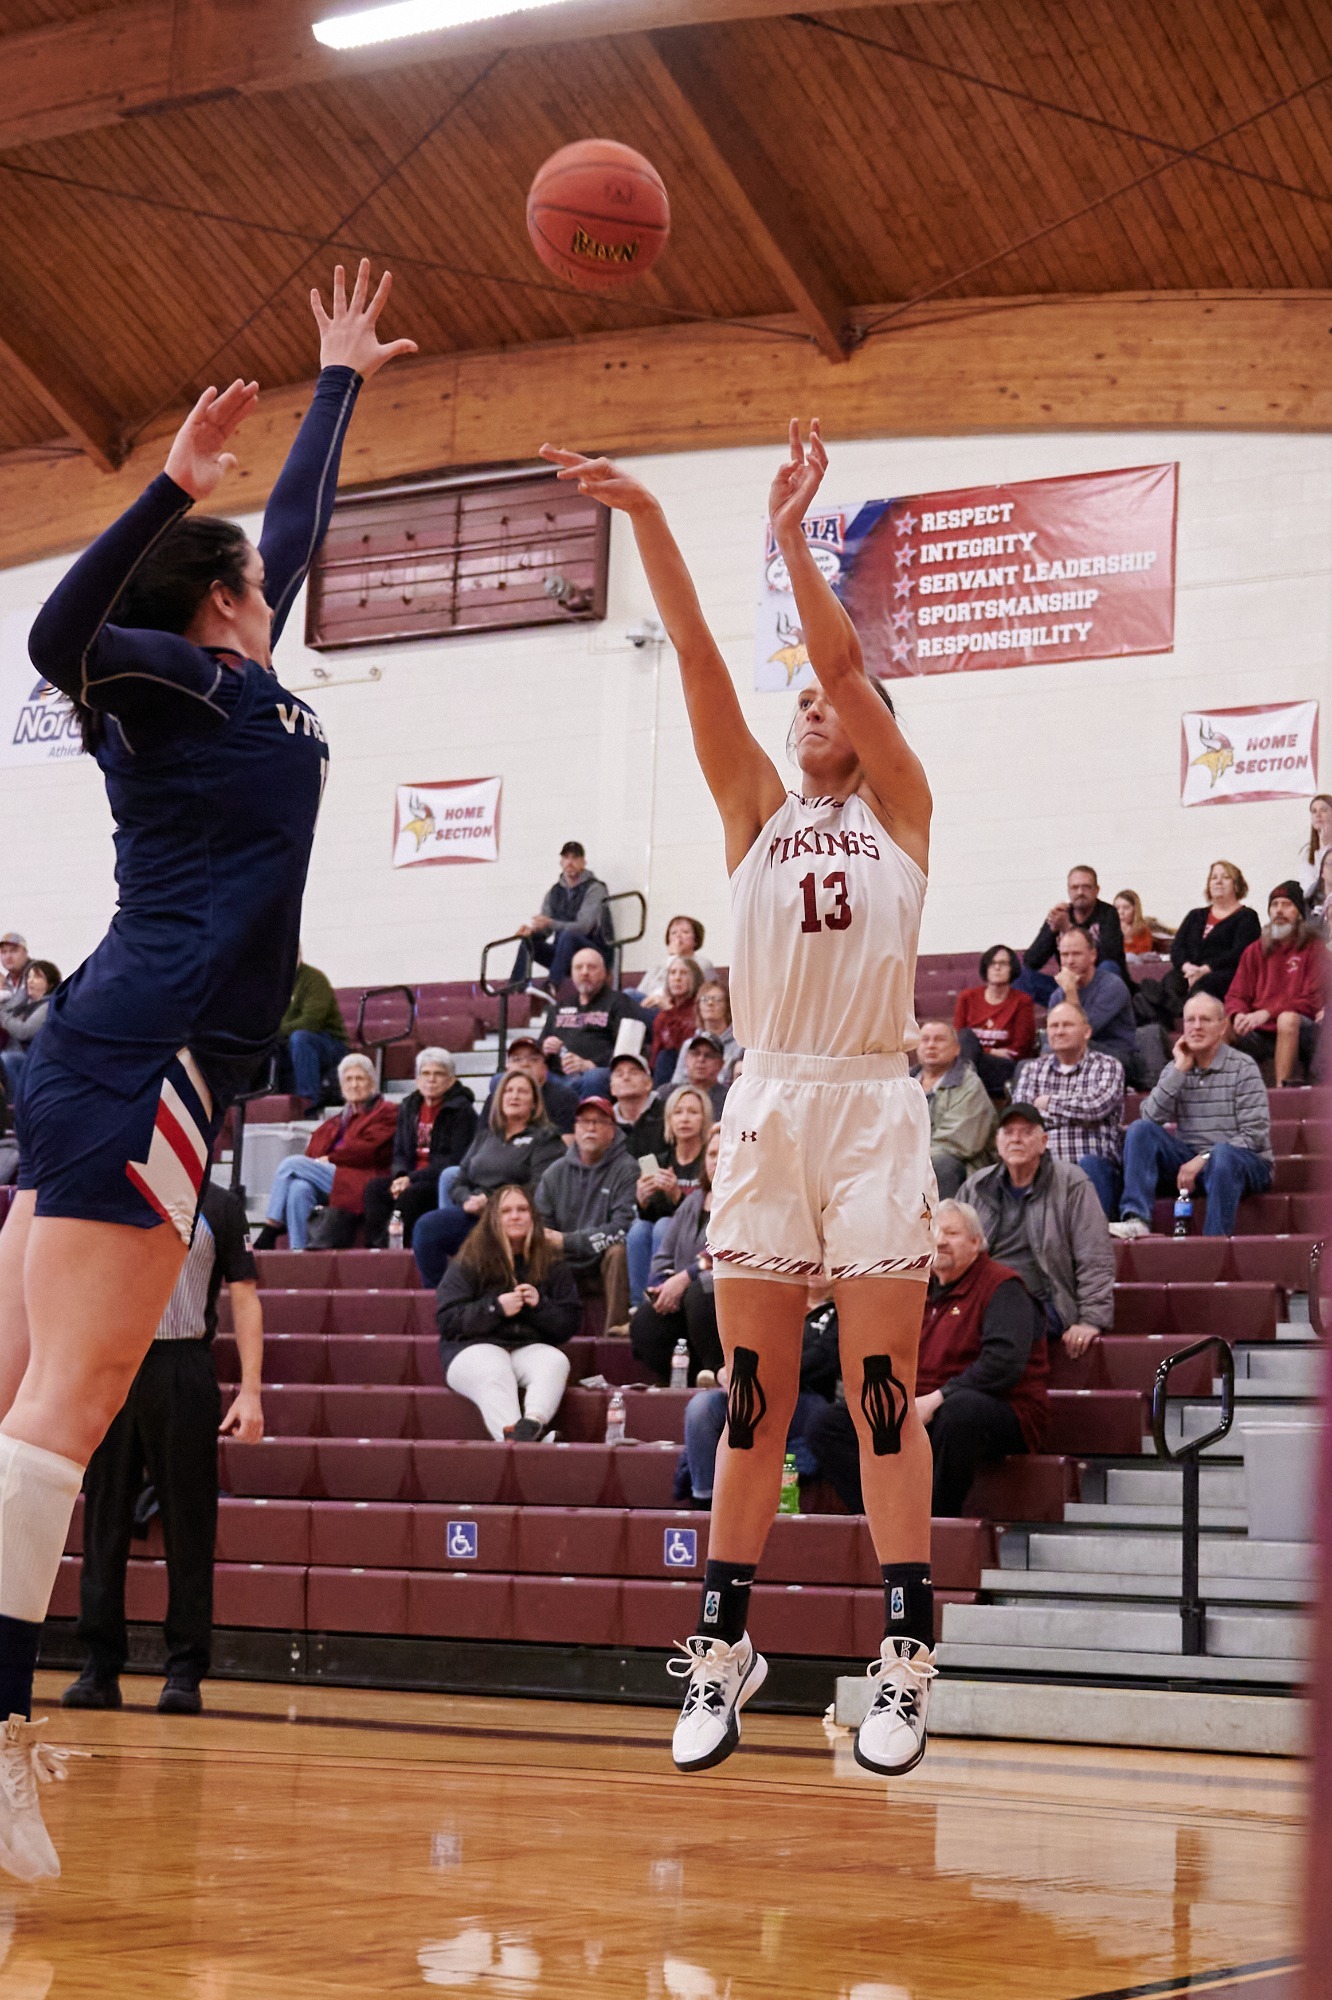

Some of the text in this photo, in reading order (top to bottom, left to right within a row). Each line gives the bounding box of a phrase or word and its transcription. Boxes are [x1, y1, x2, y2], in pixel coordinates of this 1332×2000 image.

[921, 502, 1014, 533] RESPECT
[919, 531, 1037, 564] INTEGRITY
[918, 551, 1157, 595] SERVANT LEADERSHIP
[917, 589, 1098, 627] SPORTSMANSHIP
[917, 622, 1093, 658] RESPONSIBILITY
[1246, 734, 1298, 751] HOME
[1234, 755, 1308, 775] SECTION
[444, 806, 485, 820] HOME
[435, 825, 492, 841] SECTION
[799, 871, 852, 933] 13
